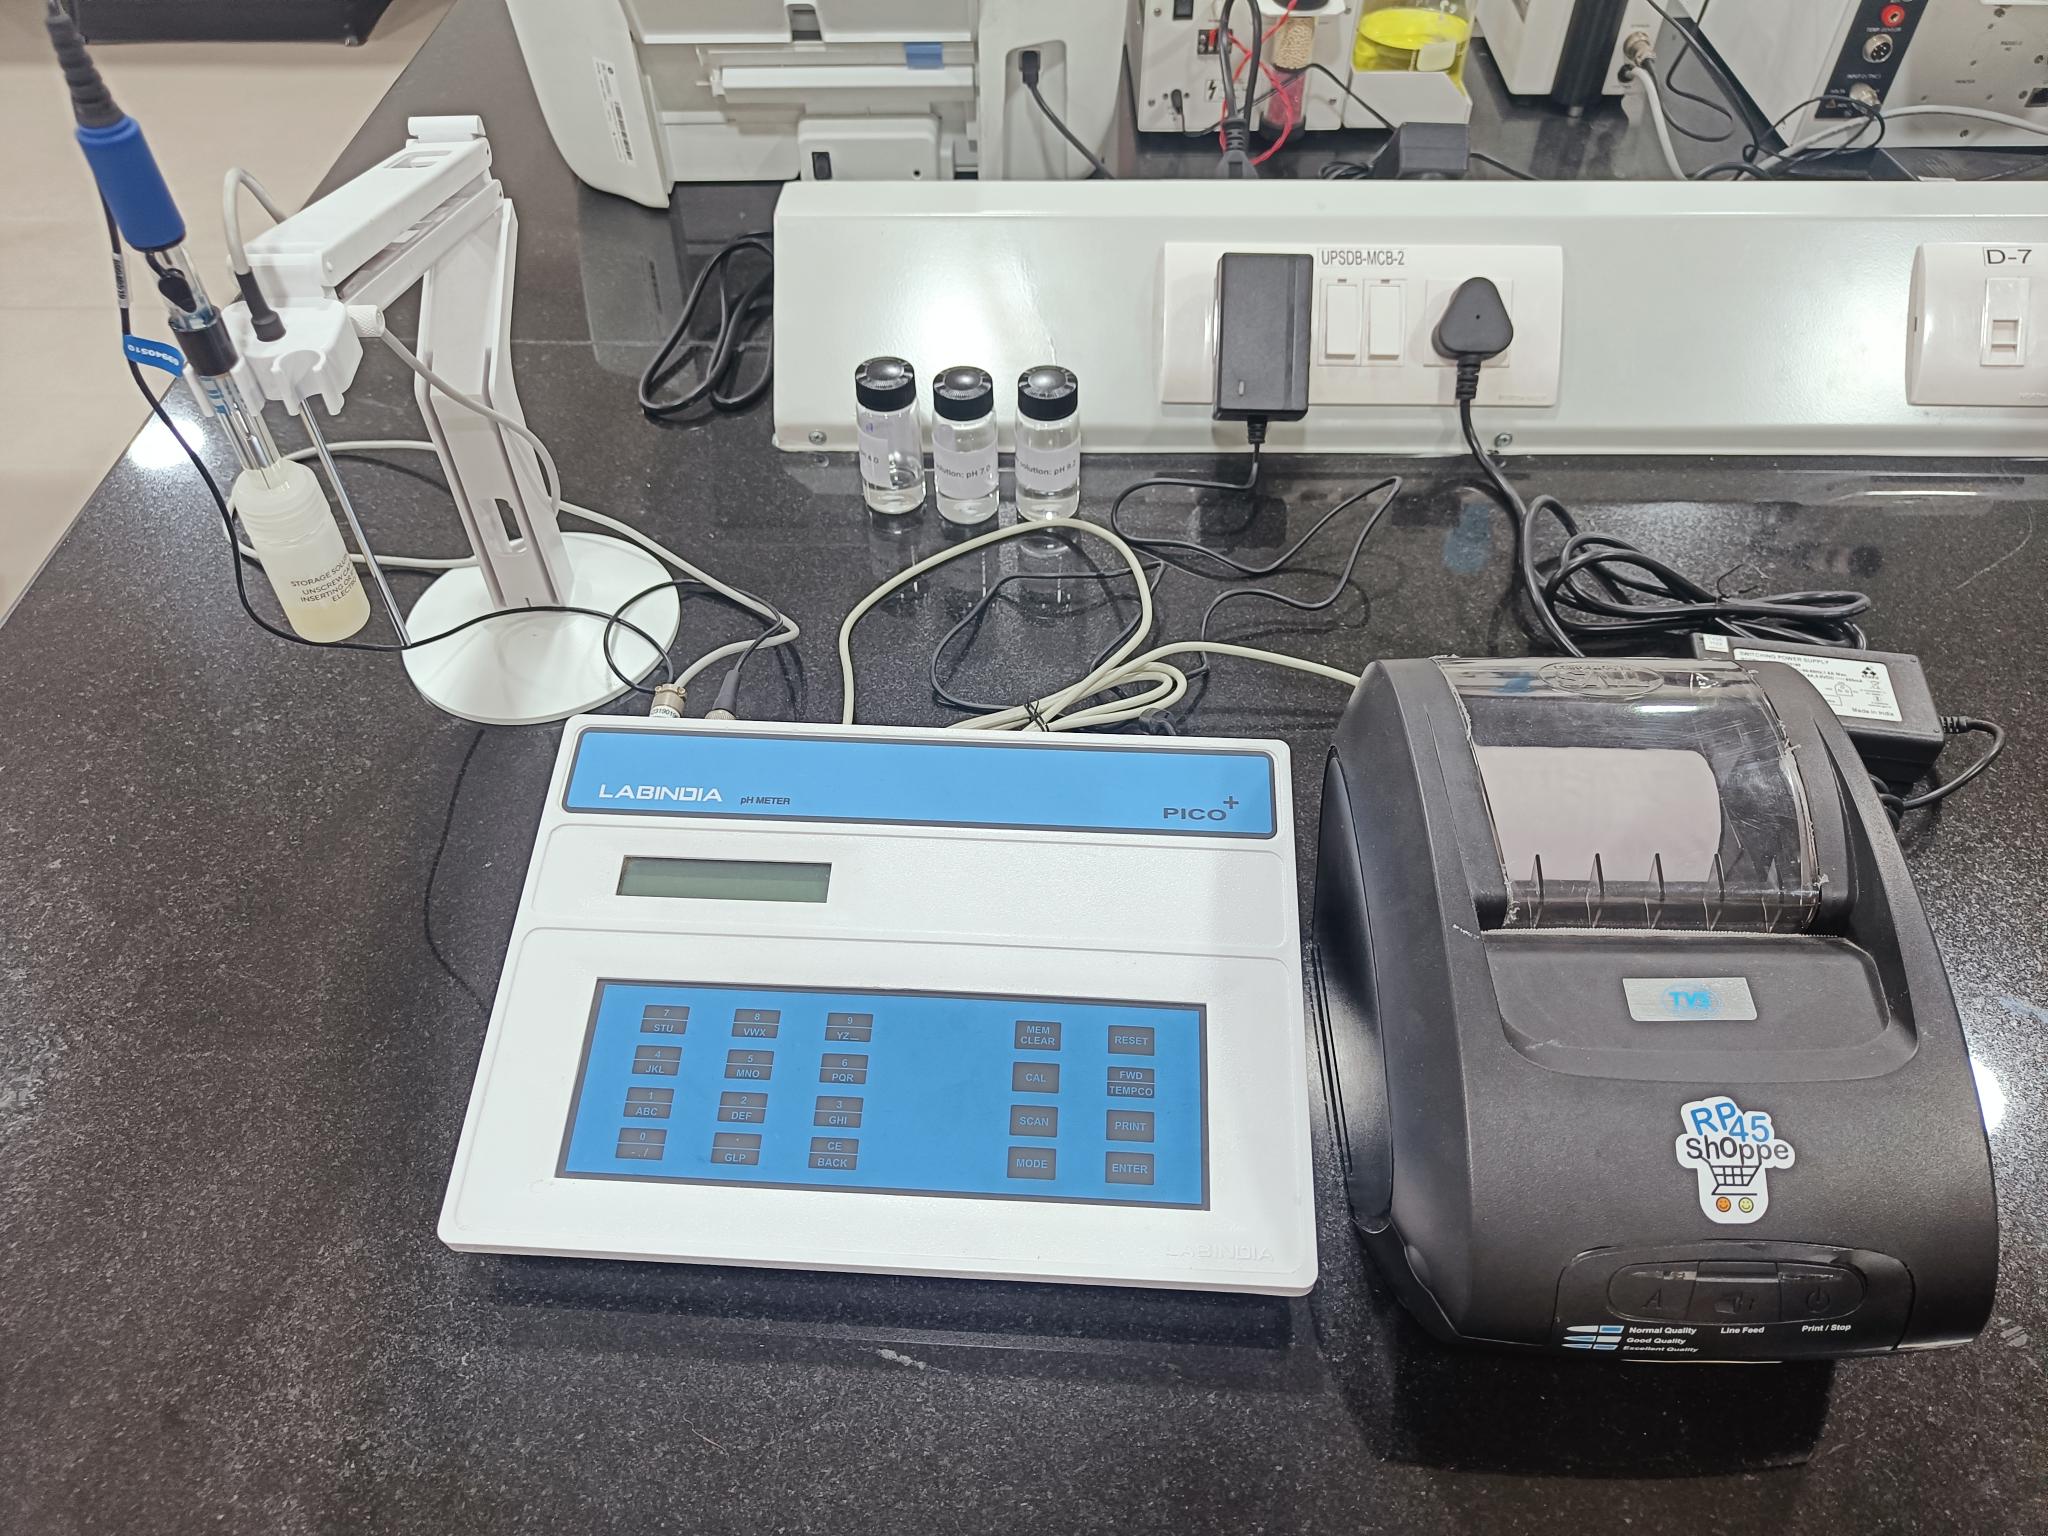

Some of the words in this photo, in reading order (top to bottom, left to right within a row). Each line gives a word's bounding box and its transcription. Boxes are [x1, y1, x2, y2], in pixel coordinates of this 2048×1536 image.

[1321, 250, 1405, 266] UPSDB-MCB-2
[1986, 249, 2032, 264] D-7
[290, 572, 332, 587] STORAGE
[302, 574, 343, 595] UNSCREW
[300, 583, 344, 602] INSERTING
[598, 783, 723, 802] LABINDIA
[740, 796, 754, 805] pH
[756, 797, 791, 805] METER
[1668, 991, 1712, 1008] TVS
[663, 1009, 670, 1017] 7
[754, 1013, 760, 1021] 8
[653, 1024, 674, 1033] STU
[744, 1028, 766, 1037] VWX
[1026, 1025, 1050, 1034] MEM
[1020, 1036, 1056, 1046] CLEAR
[1114, 1036, 1148, 1046] RESET
[747, 1055, 753, 1063] 5
[841, 1059, 848, 1067] 6
[645, 1065, 665, 1074] JKL
[736, 1069, 760, 1078] MNO
[832, 1073, 854, 1083] PQR
[1025, 1073, 1046, 1083] CAL
[1119, 1070, 1143, 1080] FWD
[1109, 1085, 1153, 1097] TEMPCO
[740, 1096, 748, 1104] 2
[836, 1101, 842, 1109] 3
[635, 1107, 658, 1116] ABC
[731, 1111, 752, 1120] DEF
[829, 1116, 848, 1125] GHI
[1018, 1116, 1049, 1127] SCAN
[1114, 1121, 1147, 1132] PRINT
[828, 1142, 842, 1151] CE
[725, 1153, 746, 1163] GLP
[817, 1158, 848, 1168] BACK
[1016, 1158, 1049, 1169] MODE
[1112, 1163, 1148, 1174] ENTER
[1664, 1327, 1697, 1335] Quality
[1742, 1326, 1765, 1334] Feed
[1831, 1324, 1852, 1332] Stop
